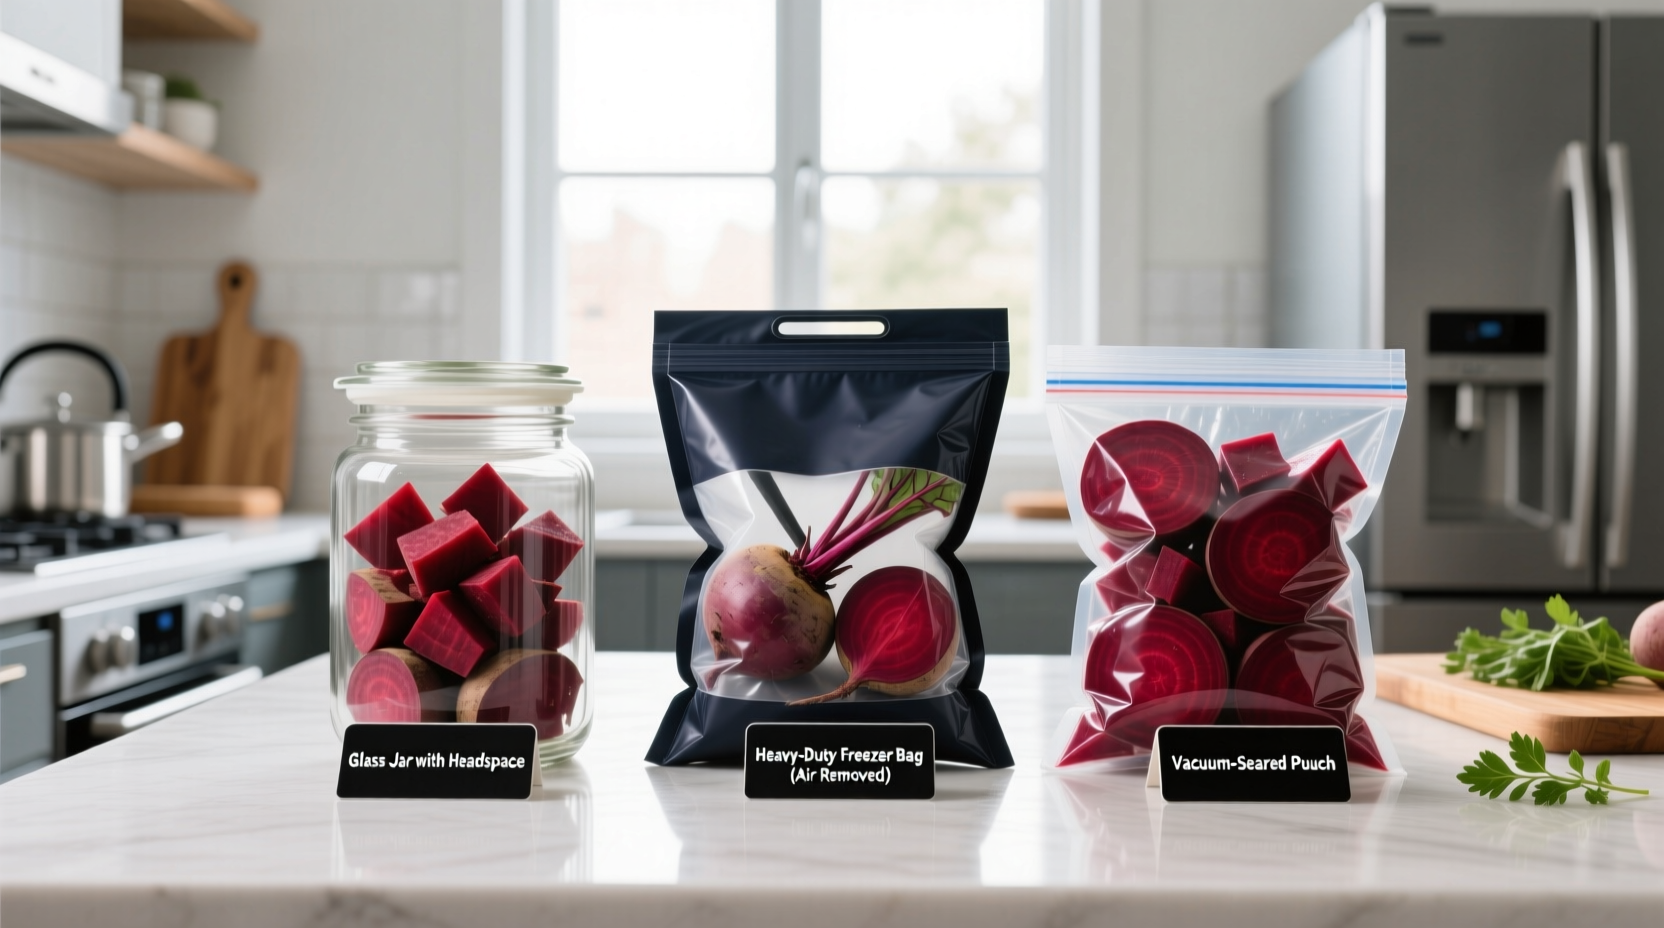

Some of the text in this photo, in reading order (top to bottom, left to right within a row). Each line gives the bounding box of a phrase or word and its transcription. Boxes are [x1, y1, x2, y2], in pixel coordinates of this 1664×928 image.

[348, 750, 526, 772] Glass Jar with Headspace
[755, 746, 924, 767] Heavy-Duty Freezer Bag
[1171, 754, 1287, 772] Vacuum-Seared
[790, 766, 892, 786] (Air Removed)
